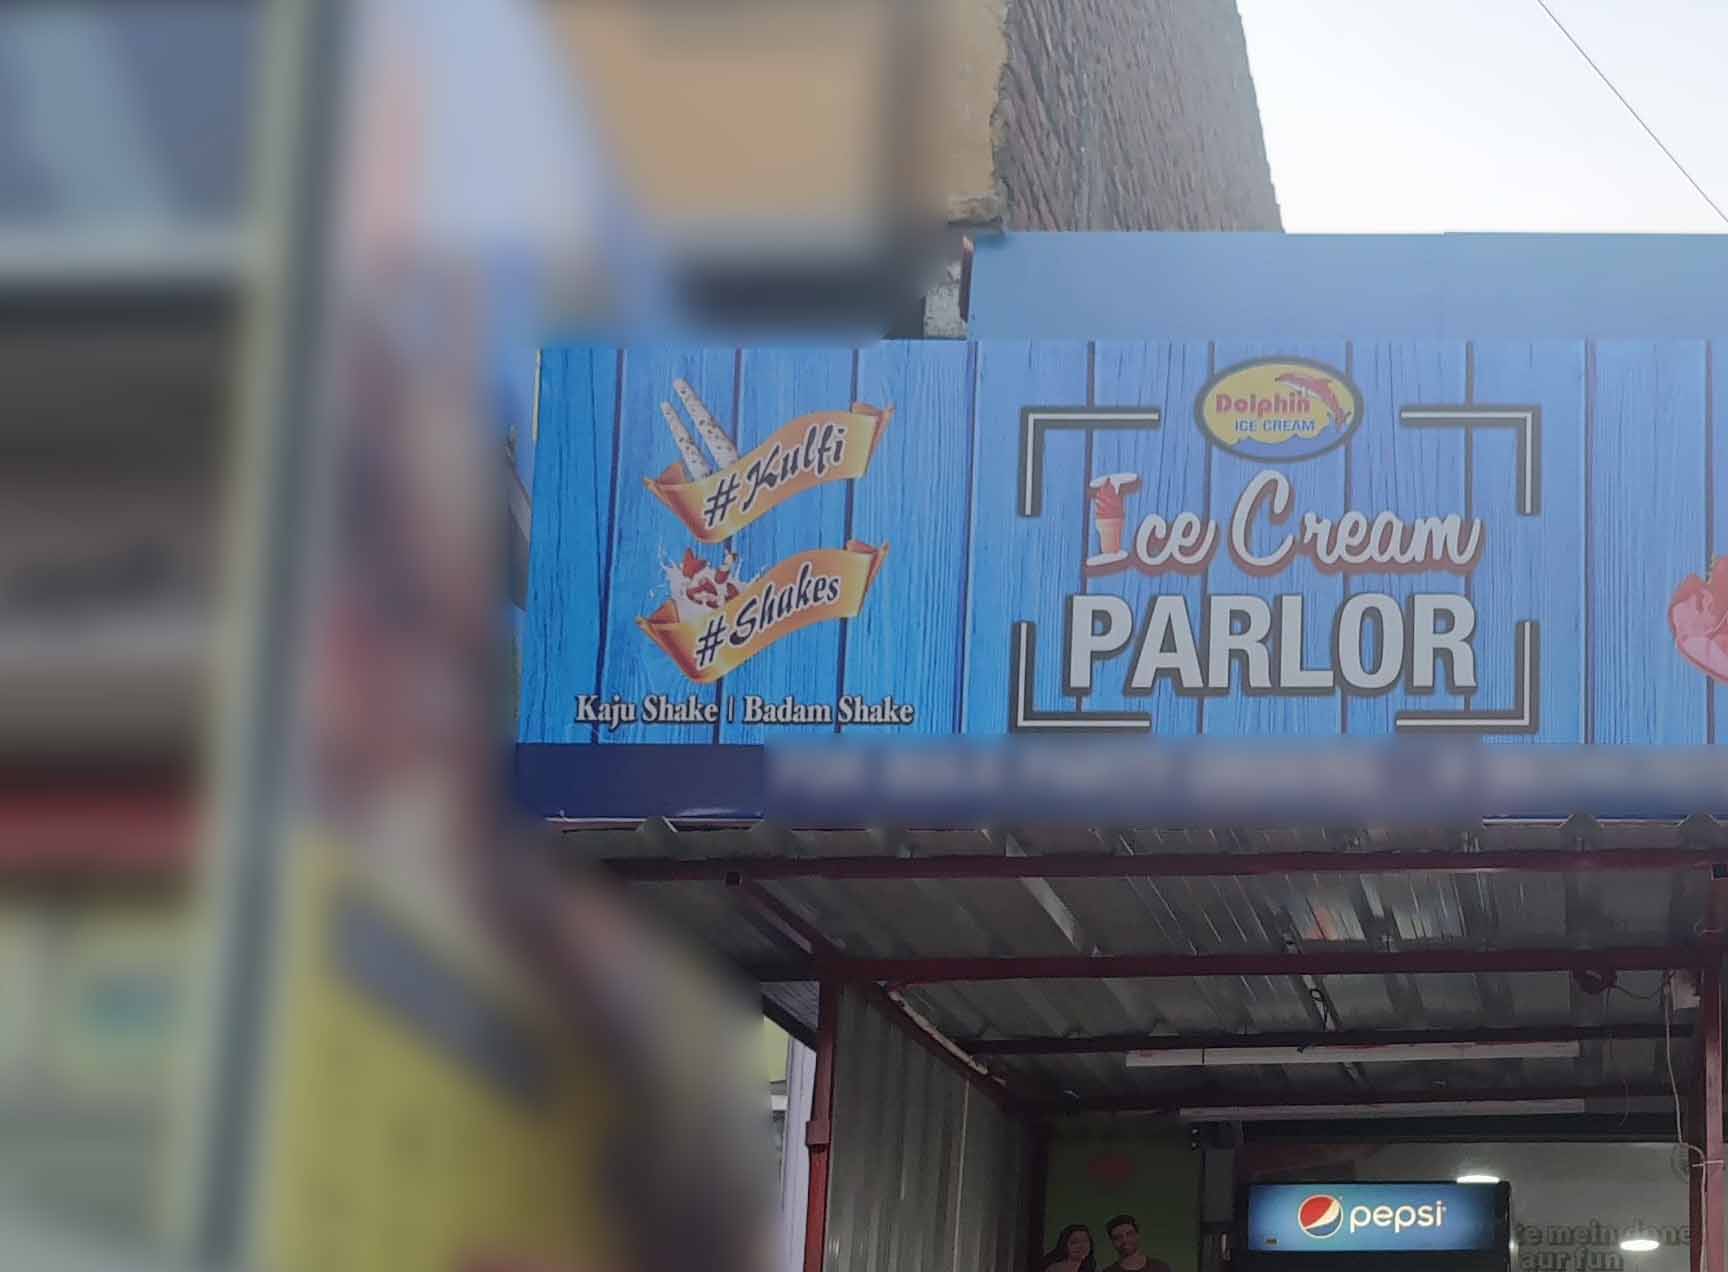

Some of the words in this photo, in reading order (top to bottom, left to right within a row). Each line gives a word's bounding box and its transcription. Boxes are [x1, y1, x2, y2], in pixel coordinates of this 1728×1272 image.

[1215, 391, 1312, 418] Dolphin
[1235, 419, 1257, 433] ICE
[1263, 419, 1315, 433] CREAM
[702, 424, 848, 528] #Kulfi
[1085, 472, 1216, 572] Ice
[1230, 469, 1483, 572] Cream
[695, 560, 842, 670] #Shakes
[1066, 592, 1478, 693] PARLOR
[575, 695, 636, 732] Kaju
[642, 694, 720, 724] Shake
[743, 694, 833, 724] Badam
[837, 694, 915, 724] Shake
[1350, 1200, 1444, 1233] pepsi
